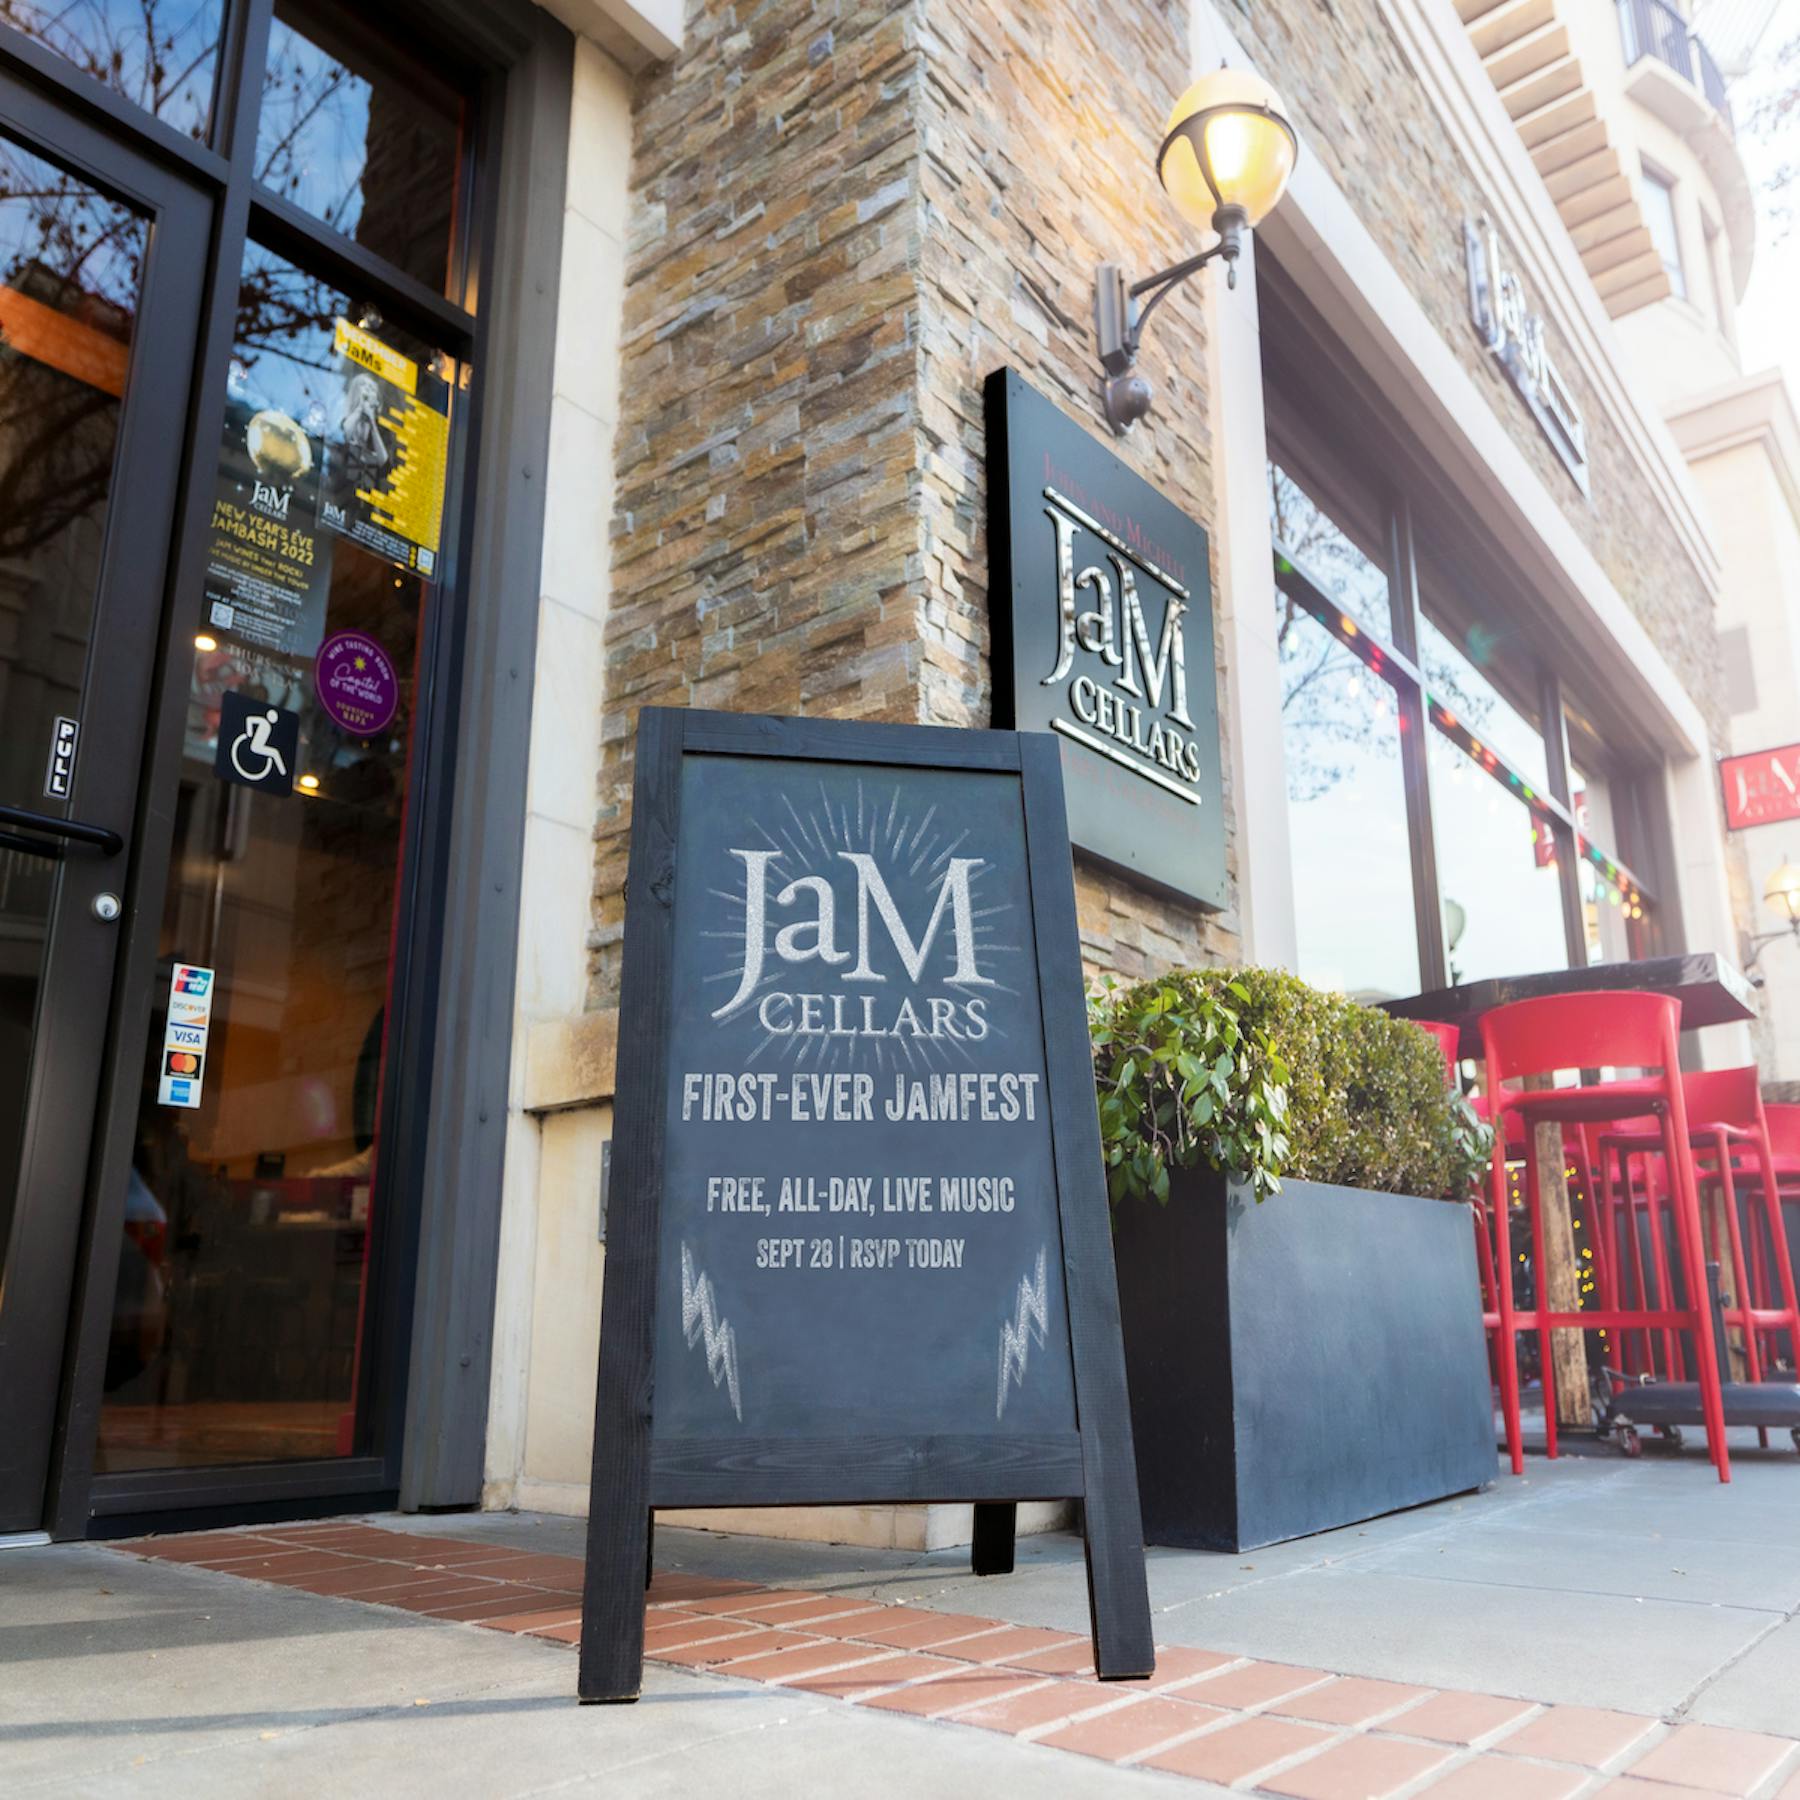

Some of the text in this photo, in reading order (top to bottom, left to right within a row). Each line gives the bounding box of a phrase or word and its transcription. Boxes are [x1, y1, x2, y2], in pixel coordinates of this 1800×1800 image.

[249, 479, 290, 514] JaM
[210, 513, 315, 567] JAMBASH 2022
[215, 500, 246, 521] NEW
[248, 514, 288, 541] YEAR'S
[1040, 506, 1196, 731] JaM
[329, 678, 383, 705] OF THE WORLD
[343, 710, 366, 726] NAPA
[1070, 675, 1200, 783] CELLARS
[52, 723, 75, 793] PULL
[711, 847, 995, 1019] JaM
[174, 1030, 201, 1044] VISA
[759, 991, 988, 1042] CELLARS
[681, 1072, 875, 1122] FIRST-EVER
[706, 1176, 1016, 1217] FREE, ALL-DAY, LIVE MUSIC
[756, 1237, 966, 1269] SEPT 28 RSVP TODAY
